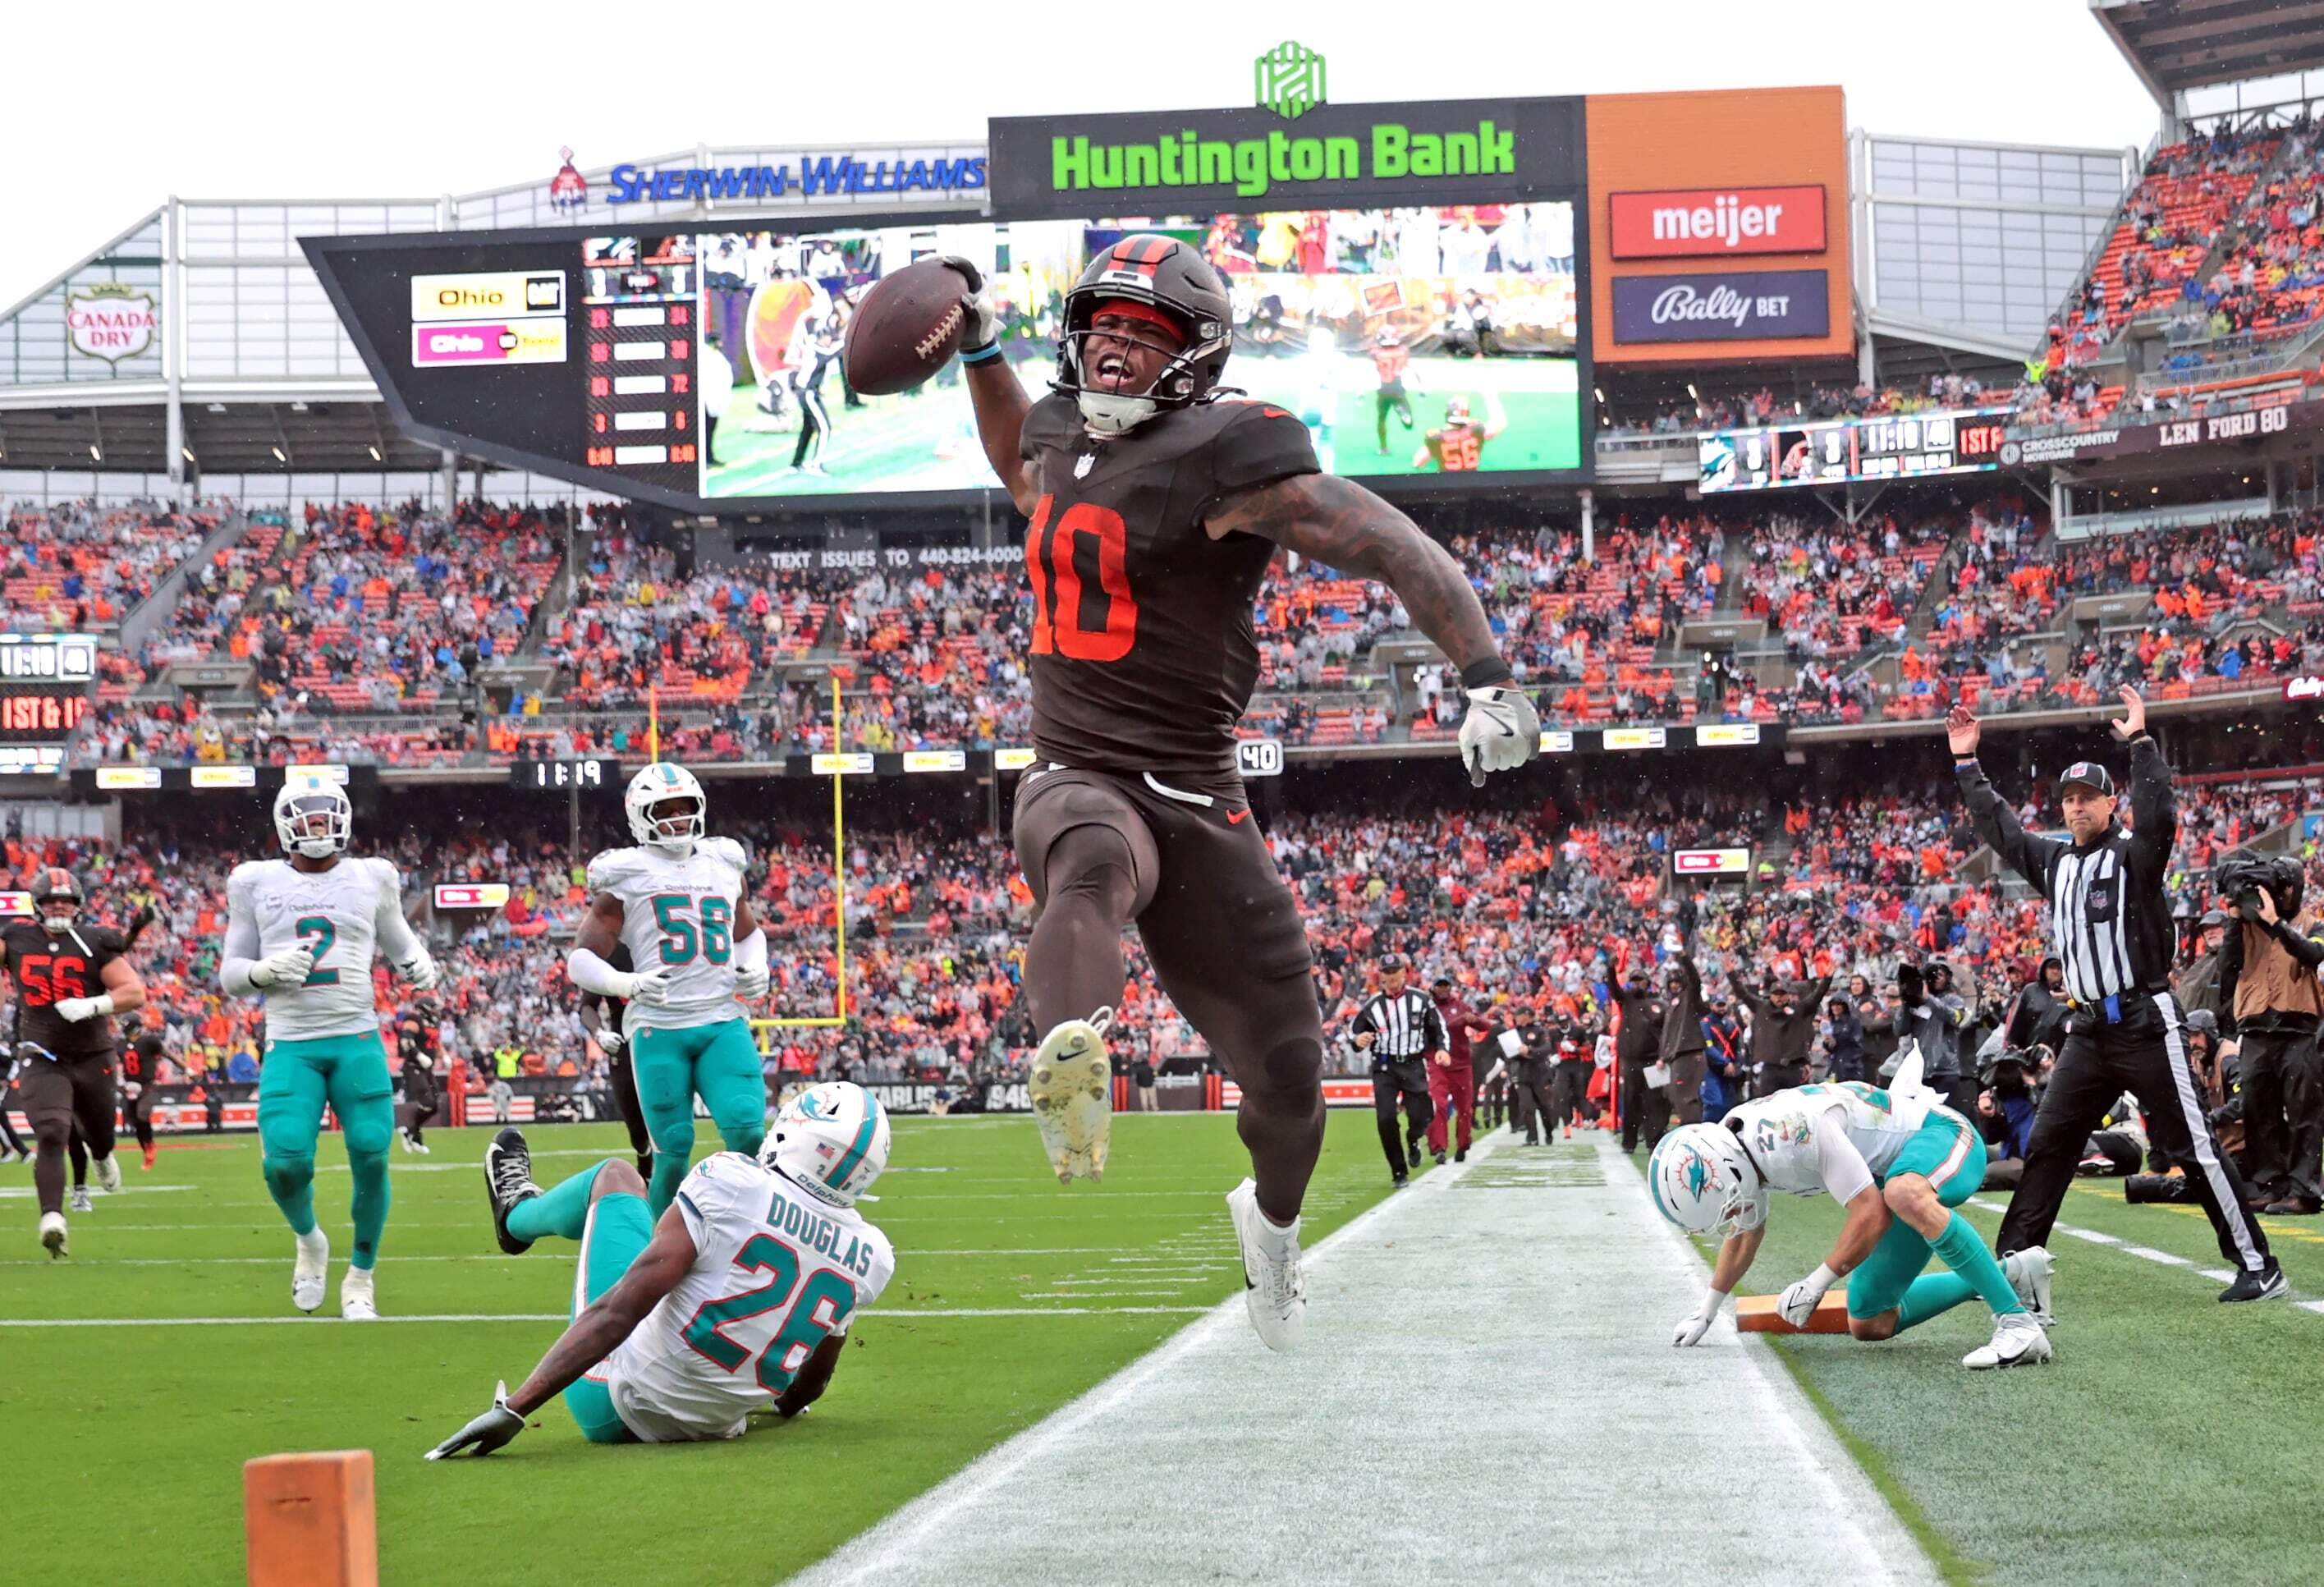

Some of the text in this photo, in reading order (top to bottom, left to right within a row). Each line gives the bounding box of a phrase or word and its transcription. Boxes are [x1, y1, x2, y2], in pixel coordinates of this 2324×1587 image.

[1052, 121, 1515, 197] Huntington Bank
[607, 156, 986, 204] SHERWIN-WILLIAMS
[1652, 195, 1783, 247] meijer
[439, 290, 503, 305] Ohio
[1651, 284, 1790, 328] Bally BET
[67, 310, 157, 329] CANADA
[91, 331, 133, 346] DRY
[2021, 429, 2120, 453] CROSSCOUNTRY
[2159, 406, 2288, 447] LEN FORD 80
[769, 552, 811, 569] TEXT
[821, 550, 876, 568] ISSUES
[885, 549, 910, 566] TO
[1026, 493, 1139, 663] 10
[2, 697, 41, 730] 1ST
[538, 759, 601, 786] 11:19
[1242, 743, 1277, 770] 40
[296, 915, 340, 988] 2
[20, 954, 86, 1007] 56
[1757, 1118, 1776, 1153] 27
[797, 1173, 849, 1207] Dolphins
[766, 1192, 873, 1277] DOUGLAS
[680, 1232, 857, 1396] 26
